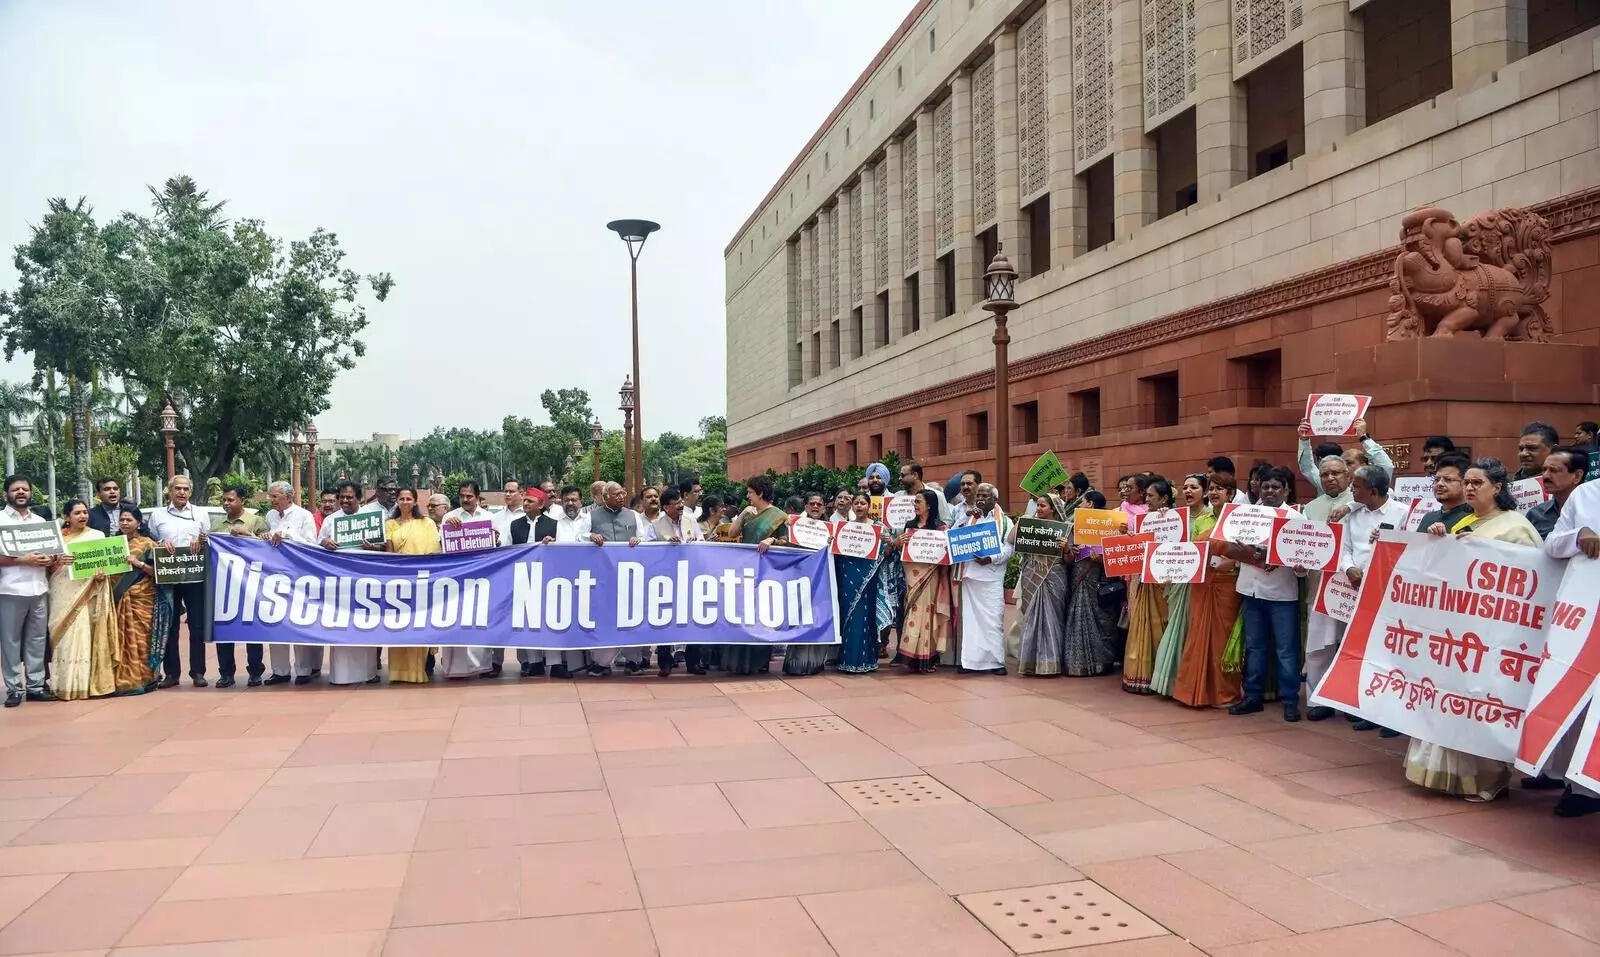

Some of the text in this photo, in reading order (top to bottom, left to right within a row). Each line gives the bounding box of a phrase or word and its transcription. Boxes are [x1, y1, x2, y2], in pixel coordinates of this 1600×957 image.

[337, 520, 349, 532] SIR
[446, 535, 493, 552] Not Deletion!
[951, 541, 981, 557] Discuss
[213, 552, 814, 630] Discussion Not Deletion
[1390, 574, 1546, 630] SILENT INVISIBLE
[1466, 558, 1539, 601] (SIR)
[1384, 618, 1423, 658] वोट
[1429, 628, 1490, 674] चोरी
[1365, 668, 1526, 730] চুপি চুপি ভোটের
